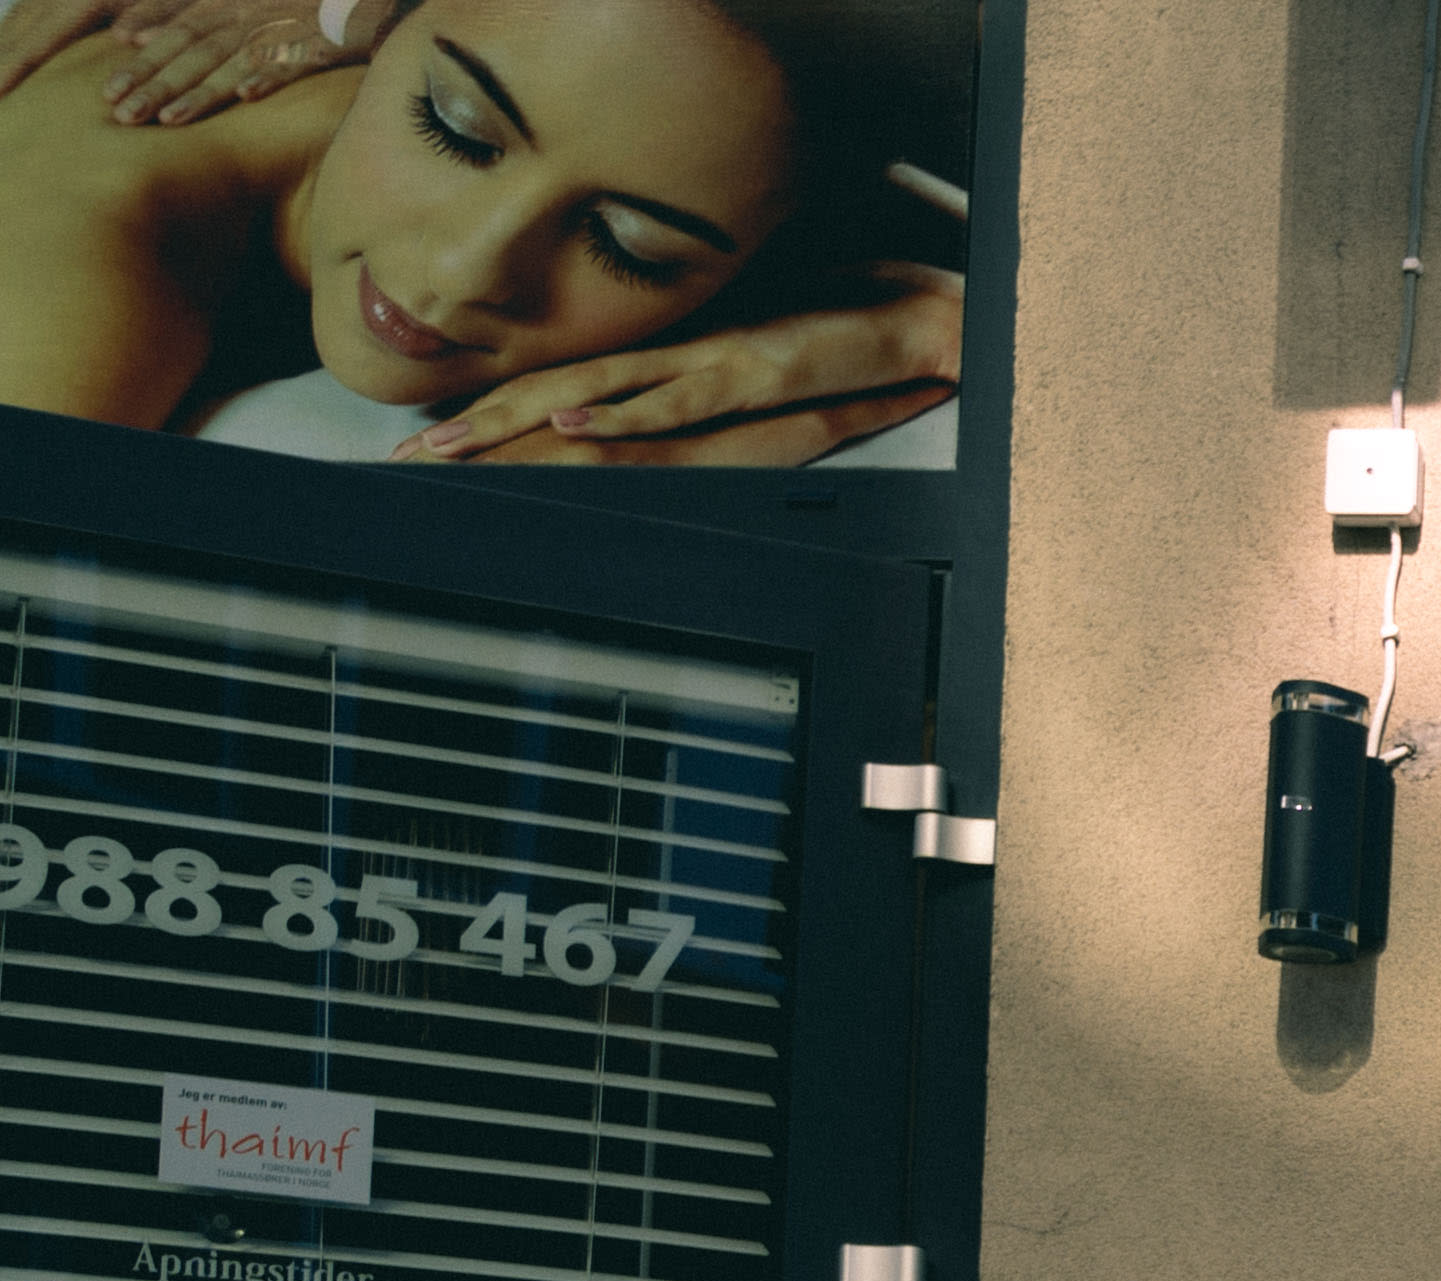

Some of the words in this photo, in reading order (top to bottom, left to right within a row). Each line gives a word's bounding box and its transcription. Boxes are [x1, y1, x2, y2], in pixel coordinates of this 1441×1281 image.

[0, 823, 222, 936] 988
[262, 864, 420, 962] 85
[460, 891, 696, 993] 467
[178, 1088, 200, 1102] Jeg
[203, 1092, 215, 1102] er
[219, 1094, 268, 1108] medlem
[270, 1100, 288, 1110] av:
[175, 1108, 361, 1172] thaimf
